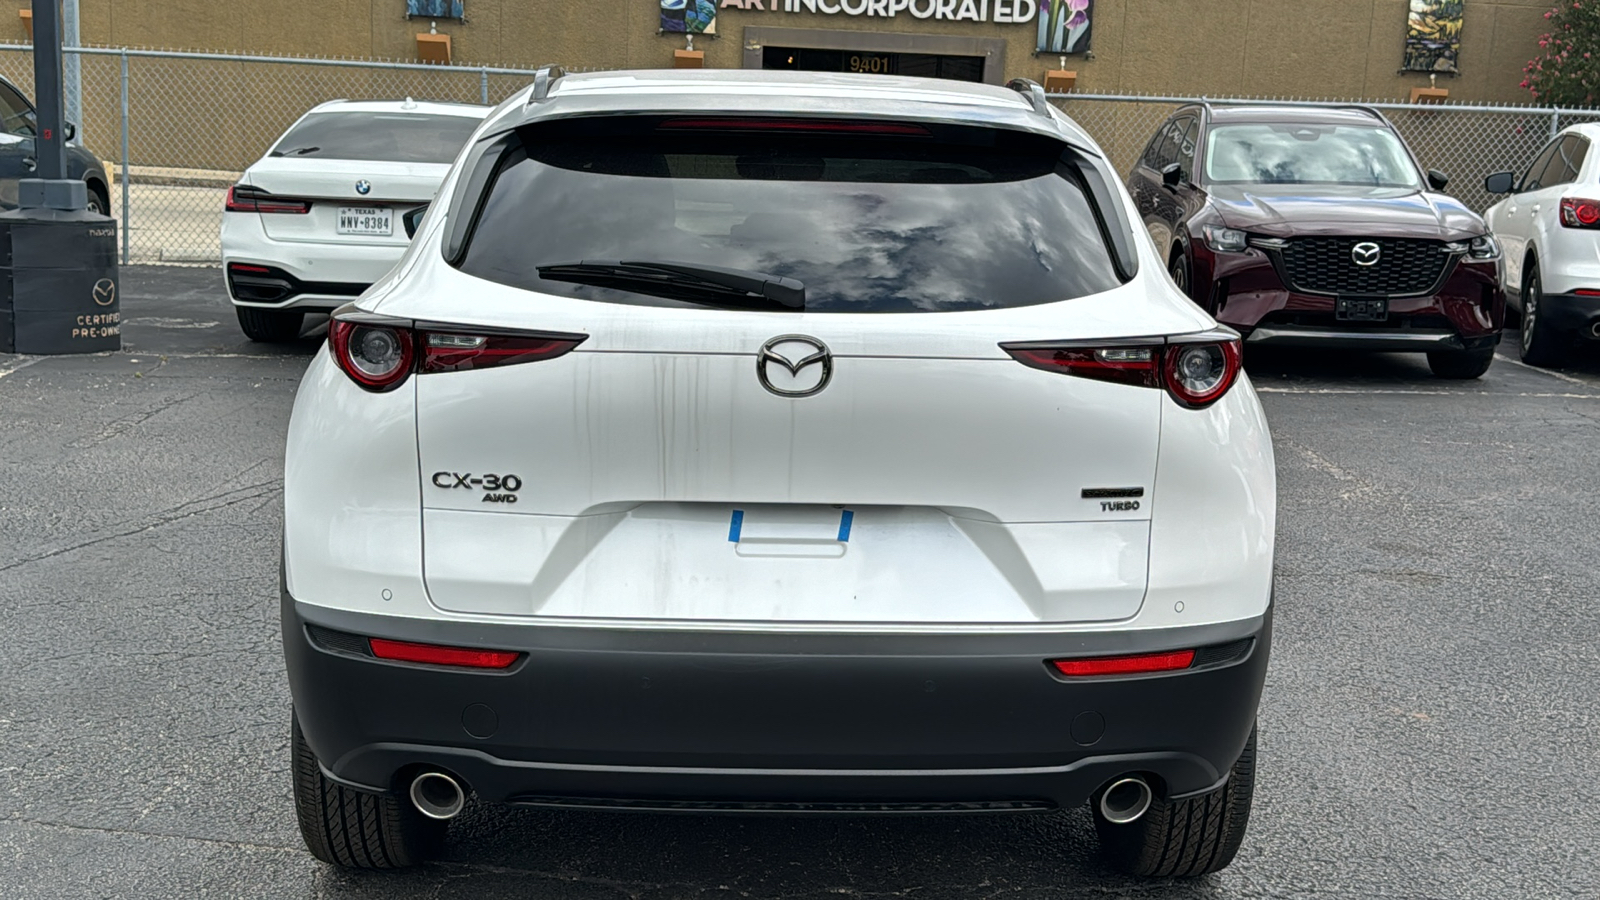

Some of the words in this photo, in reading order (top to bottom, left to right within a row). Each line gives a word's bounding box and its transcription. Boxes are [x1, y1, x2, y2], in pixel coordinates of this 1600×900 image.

[850, 55, 888, 73] 9401
[431, 471, 522, 492] CX-30
[481, 493, 518, 503] AWD
[1100, 500, 1140, 512] TURBO
